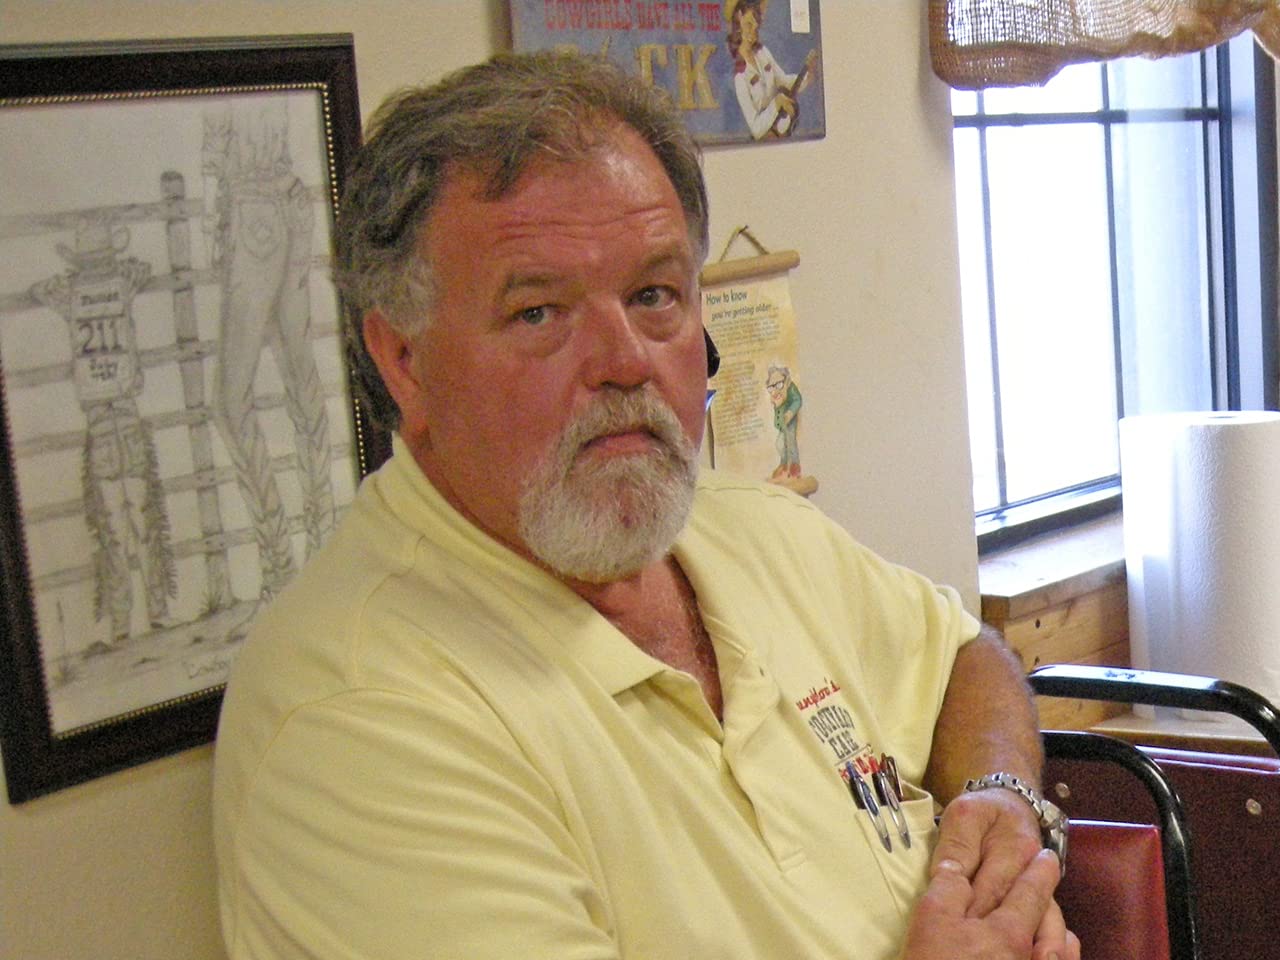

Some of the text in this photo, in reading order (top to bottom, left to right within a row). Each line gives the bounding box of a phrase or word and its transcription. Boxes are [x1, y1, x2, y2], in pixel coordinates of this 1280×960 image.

[706, 288, 748, 305] How to know
